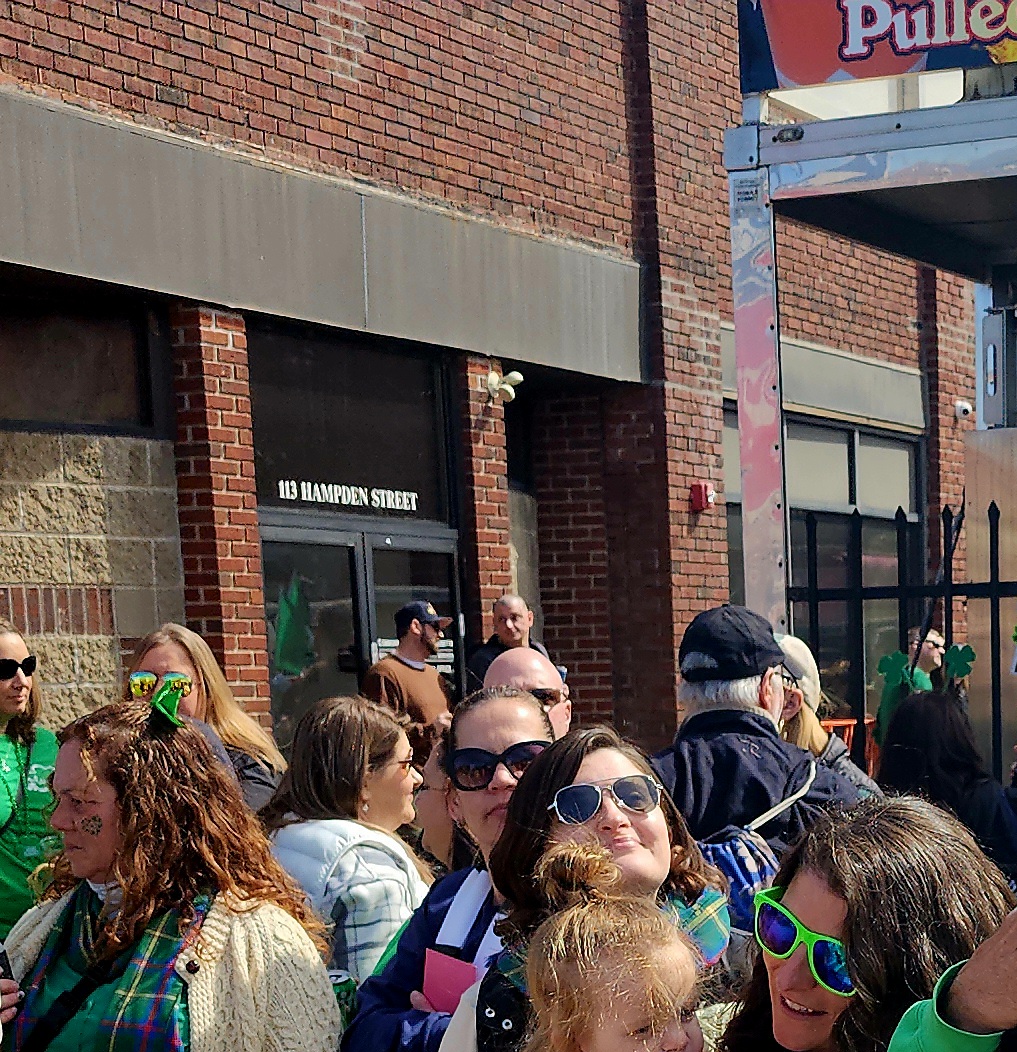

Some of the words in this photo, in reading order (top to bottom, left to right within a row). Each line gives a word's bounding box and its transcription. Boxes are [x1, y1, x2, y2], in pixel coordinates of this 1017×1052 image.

[278, 479, 298, 500] 113
[300, 481, 369, 507] HAMPDEN
[370, 488, 419, 511] STREET
